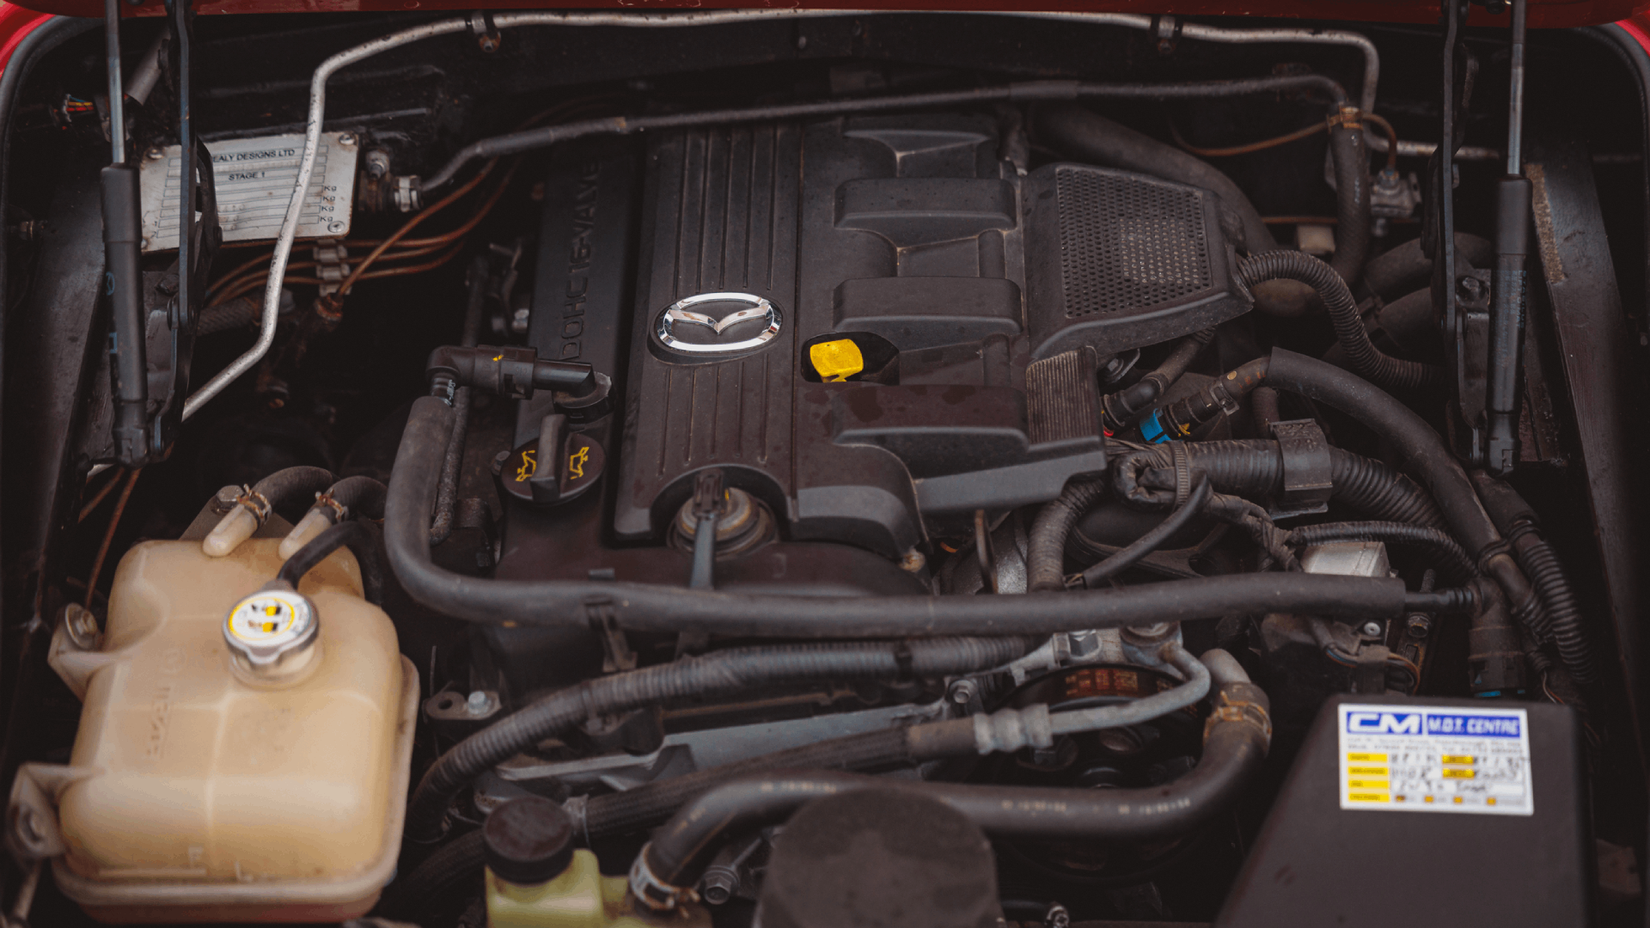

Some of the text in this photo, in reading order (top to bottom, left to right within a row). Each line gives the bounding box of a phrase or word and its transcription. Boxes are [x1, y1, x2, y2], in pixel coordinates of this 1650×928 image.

[213, 149, 296, 163] EALY DESIGNS LTD
[229, 172, 259, 181] STAGE
[558, 276, 588, 361] DOHC
[1348, 713, 1421, 734] CM
[1467, 718, 1519, 735] CENTRE
